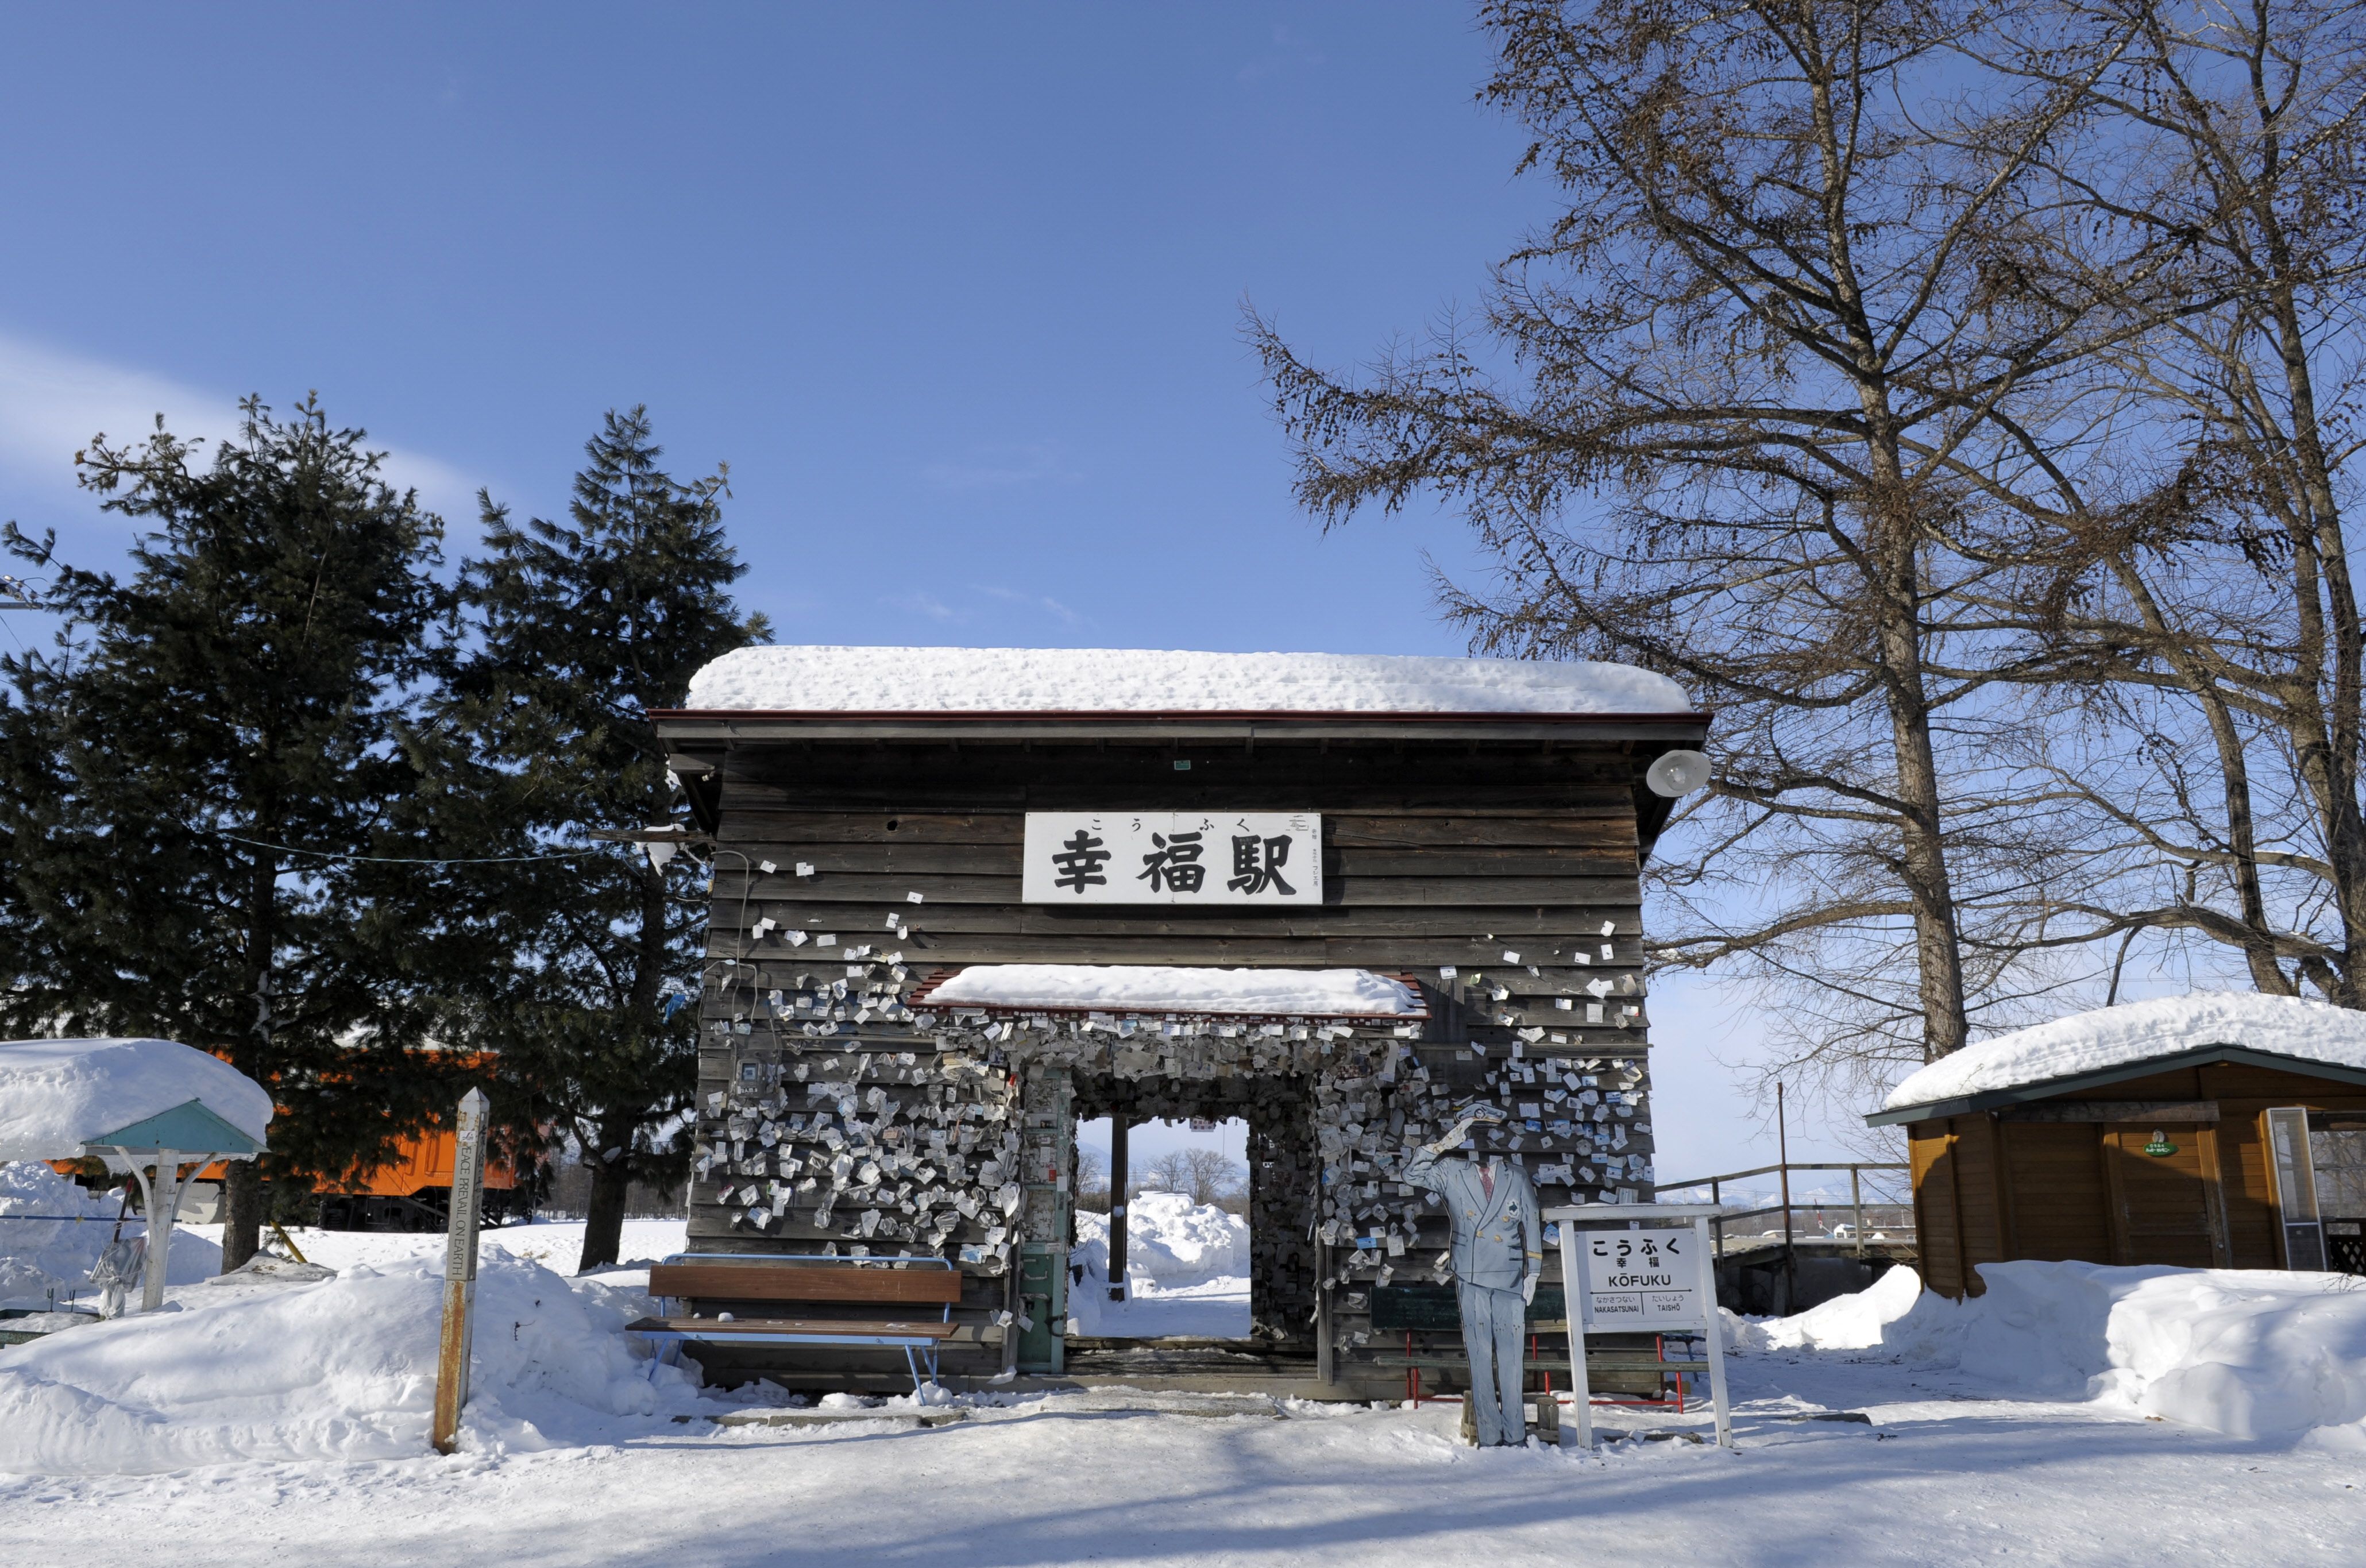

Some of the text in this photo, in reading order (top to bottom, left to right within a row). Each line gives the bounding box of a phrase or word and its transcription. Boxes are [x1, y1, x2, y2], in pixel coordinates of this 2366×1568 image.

[1091, 818, 1250, 832] こうふく
[1052, 829, 1296, 895] 幸福駅
[457, 1177, 469, 1216] PREVAIL
[456, 1220, 466, 1235] ON
[1593, 1237, 1680, 1257] こうふく
[452, 1239, 465, 1276] EARTH
[1616, 1257, 1659, 1268] 幸福
[1608, 1273, 1671, 1287] KŌFUKU
[1596, 1296, 1635, 1304] なかさつない
[1652, 1295, 1684, 1303] たいしょう
[1594, 1305, 1639, 1314] NAKASATSUNAI
[1657, 1303, 1681, 1312] TAISHŌ
